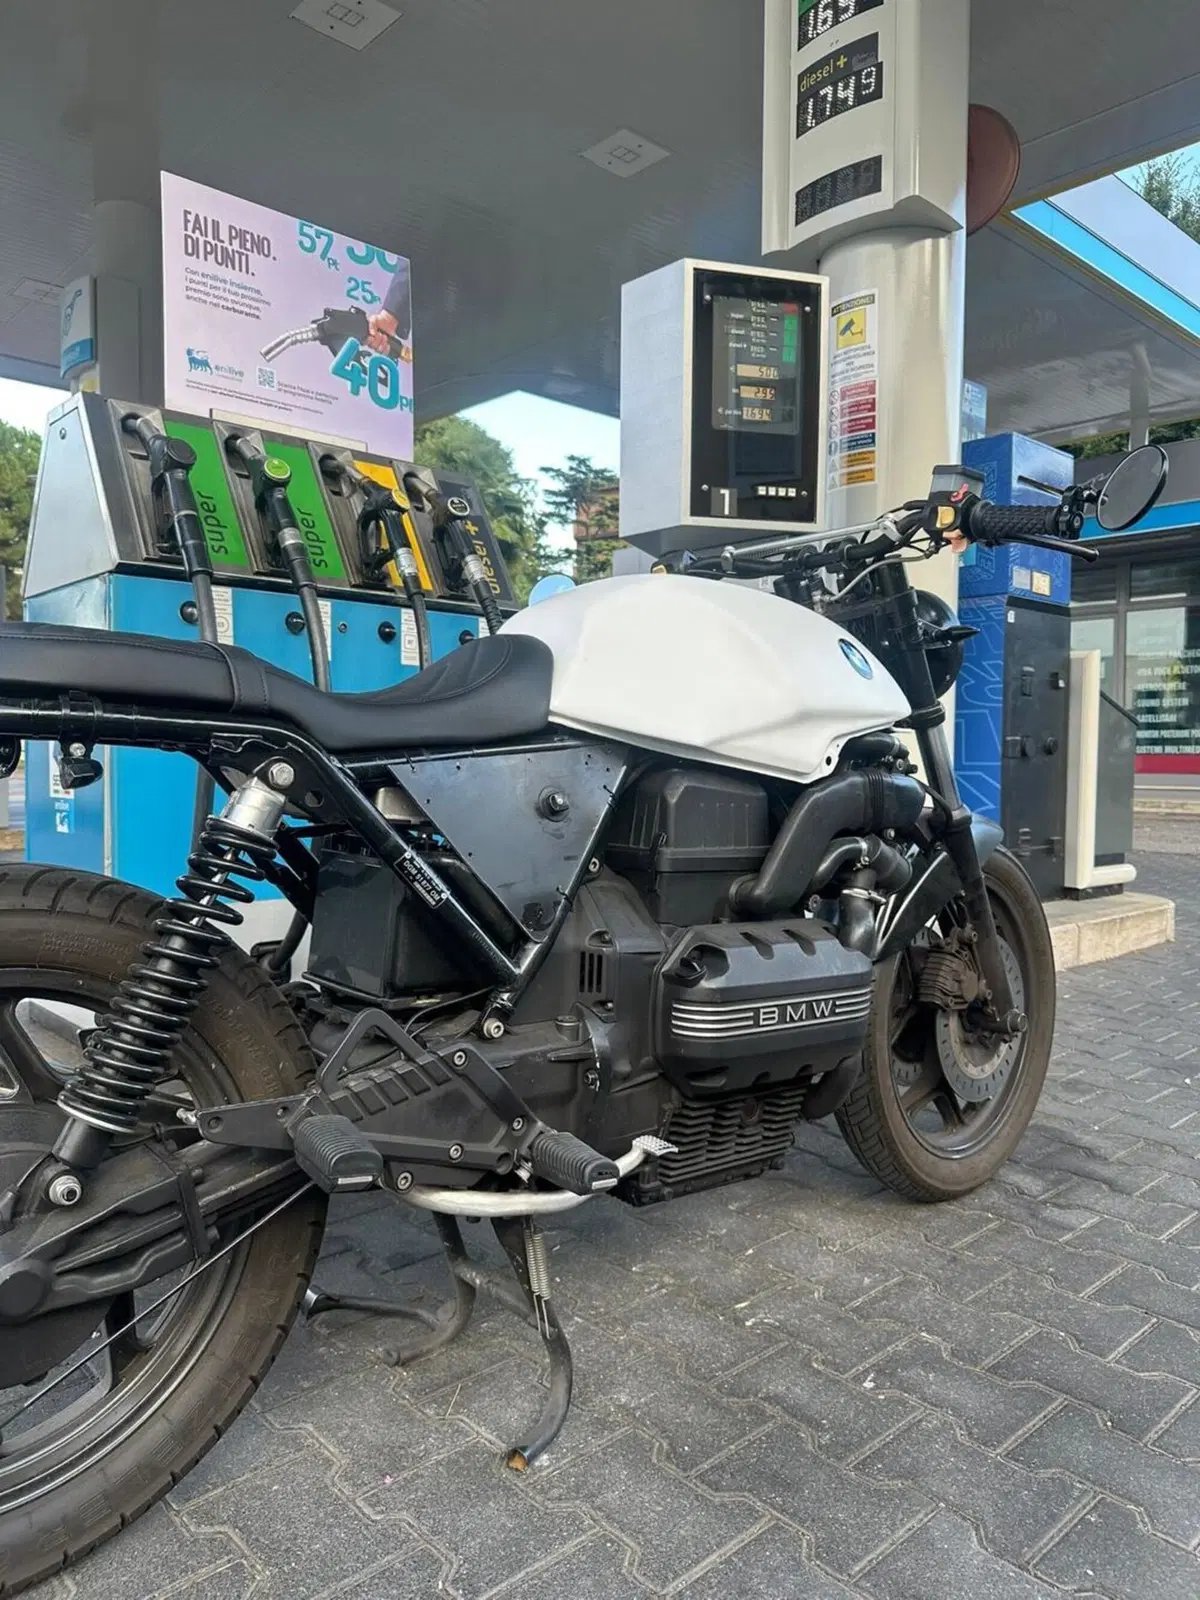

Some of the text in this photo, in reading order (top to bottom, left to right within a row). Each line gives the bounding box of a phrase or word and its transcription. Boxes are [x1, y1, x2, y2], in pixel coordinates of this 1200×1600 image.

[800, 58, 834, 92] diesel
[183, 208, 277, 262] FAI IL PIENO.
[297, 220, 334, 261] 57
[184, 233, 256, 277] DI PUNTI.
[345, 276, 376, 305] 25
[214, 364, 245, 378] enilive
[331, 336, 400, 411] 40
[754, 387, 776, 401] 295
[719, 488, 730, 516] 1
[196, 490, 229, 556] super
[297, 507, 328, 569] super
[760, 1000, 833, 1025] BMW
